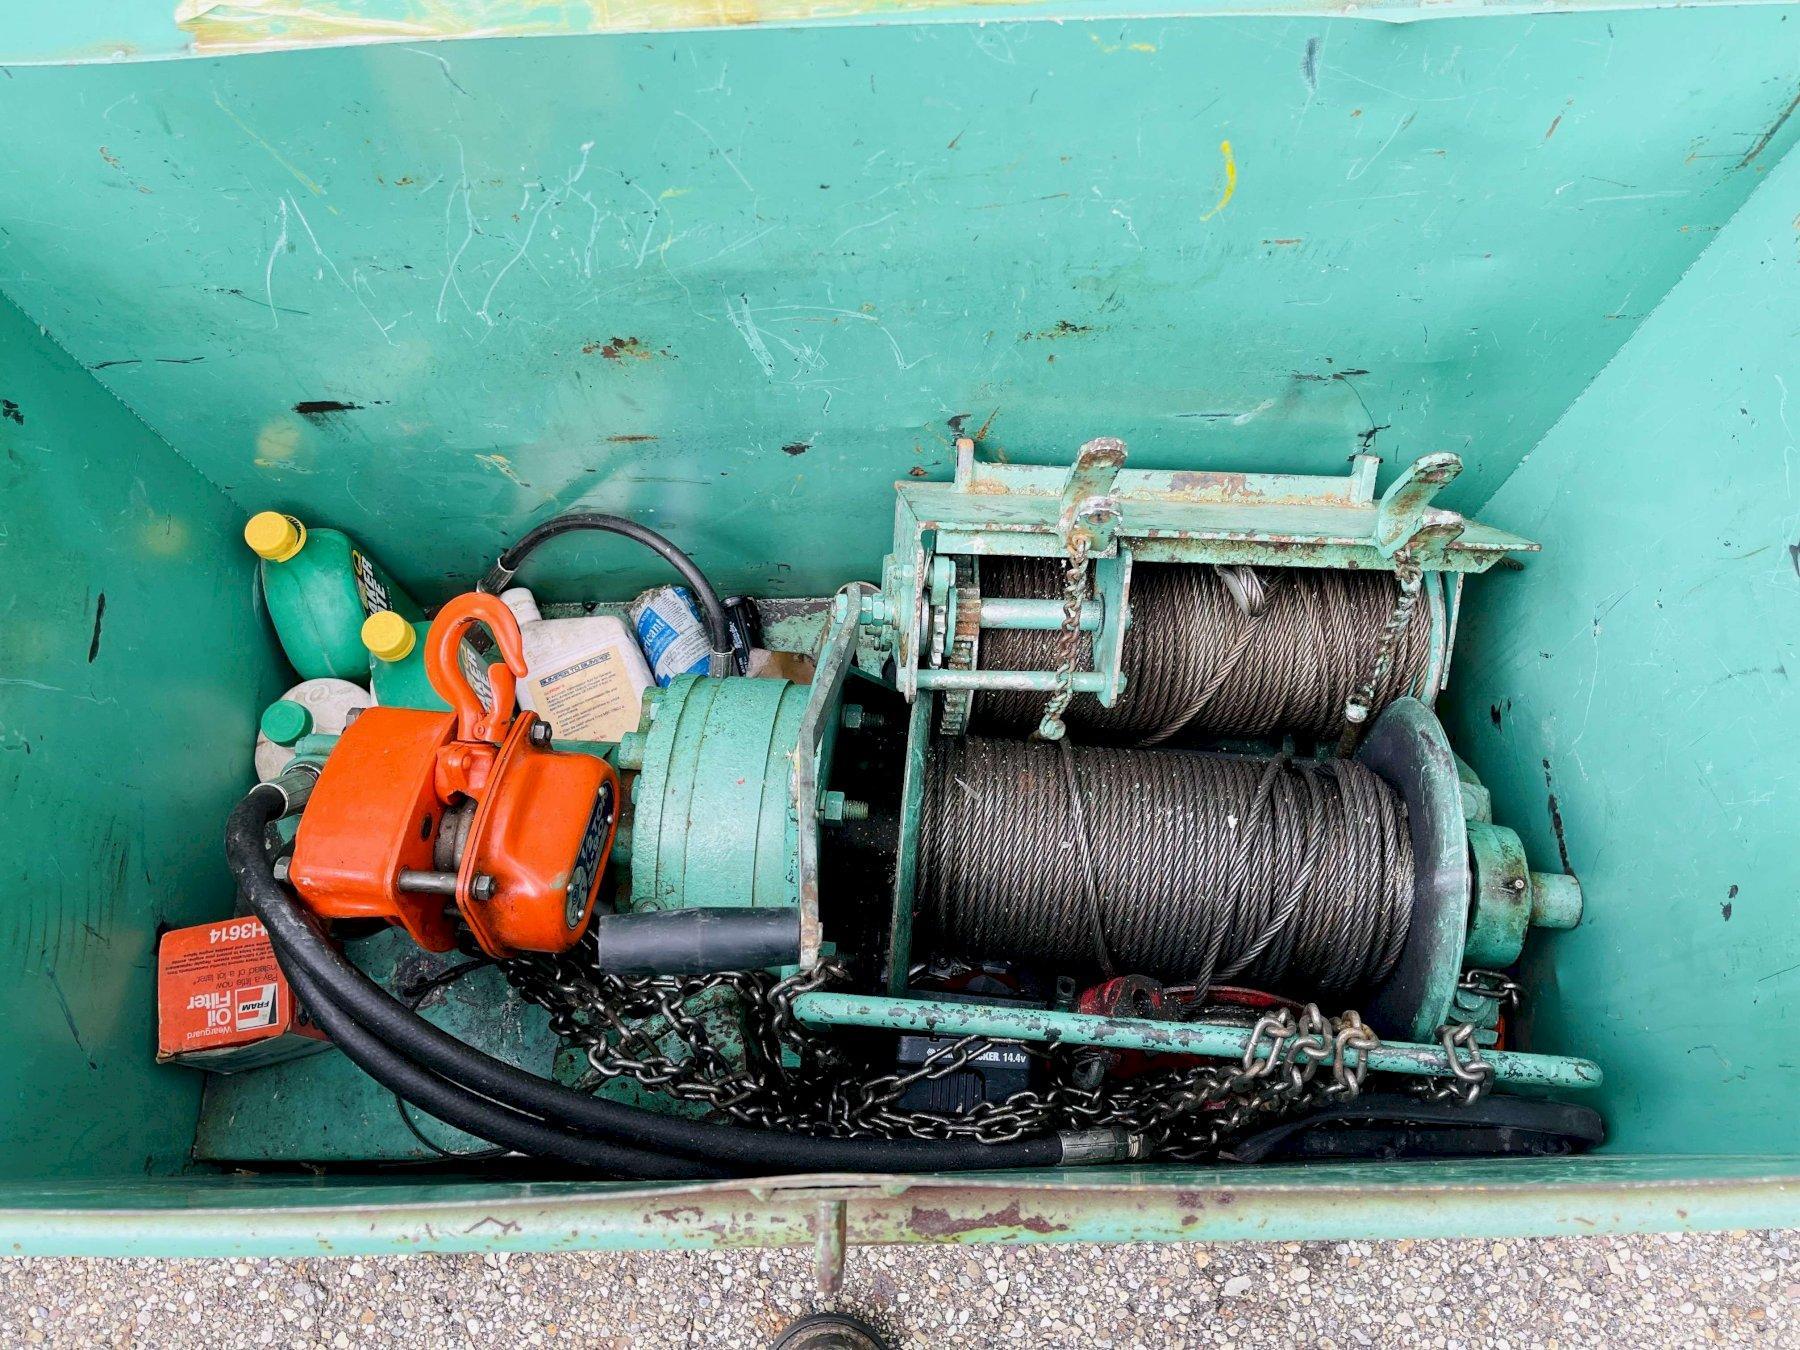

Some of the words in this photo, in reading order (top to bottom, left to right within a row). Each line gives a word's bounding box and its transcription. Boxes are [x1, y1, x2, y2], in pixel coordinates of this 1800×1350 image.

[362, 555, 375, 616] AKER
[263, 972, 277, 981] Pay
[215, 980, 233, 988] now
[187, 989, 231, 1009] Filter
[242, 1000, 269, 1011] FRAM
[207, 1006, 232, 1026] Oil
[186, 1025, 231, 1039] Wearguard
